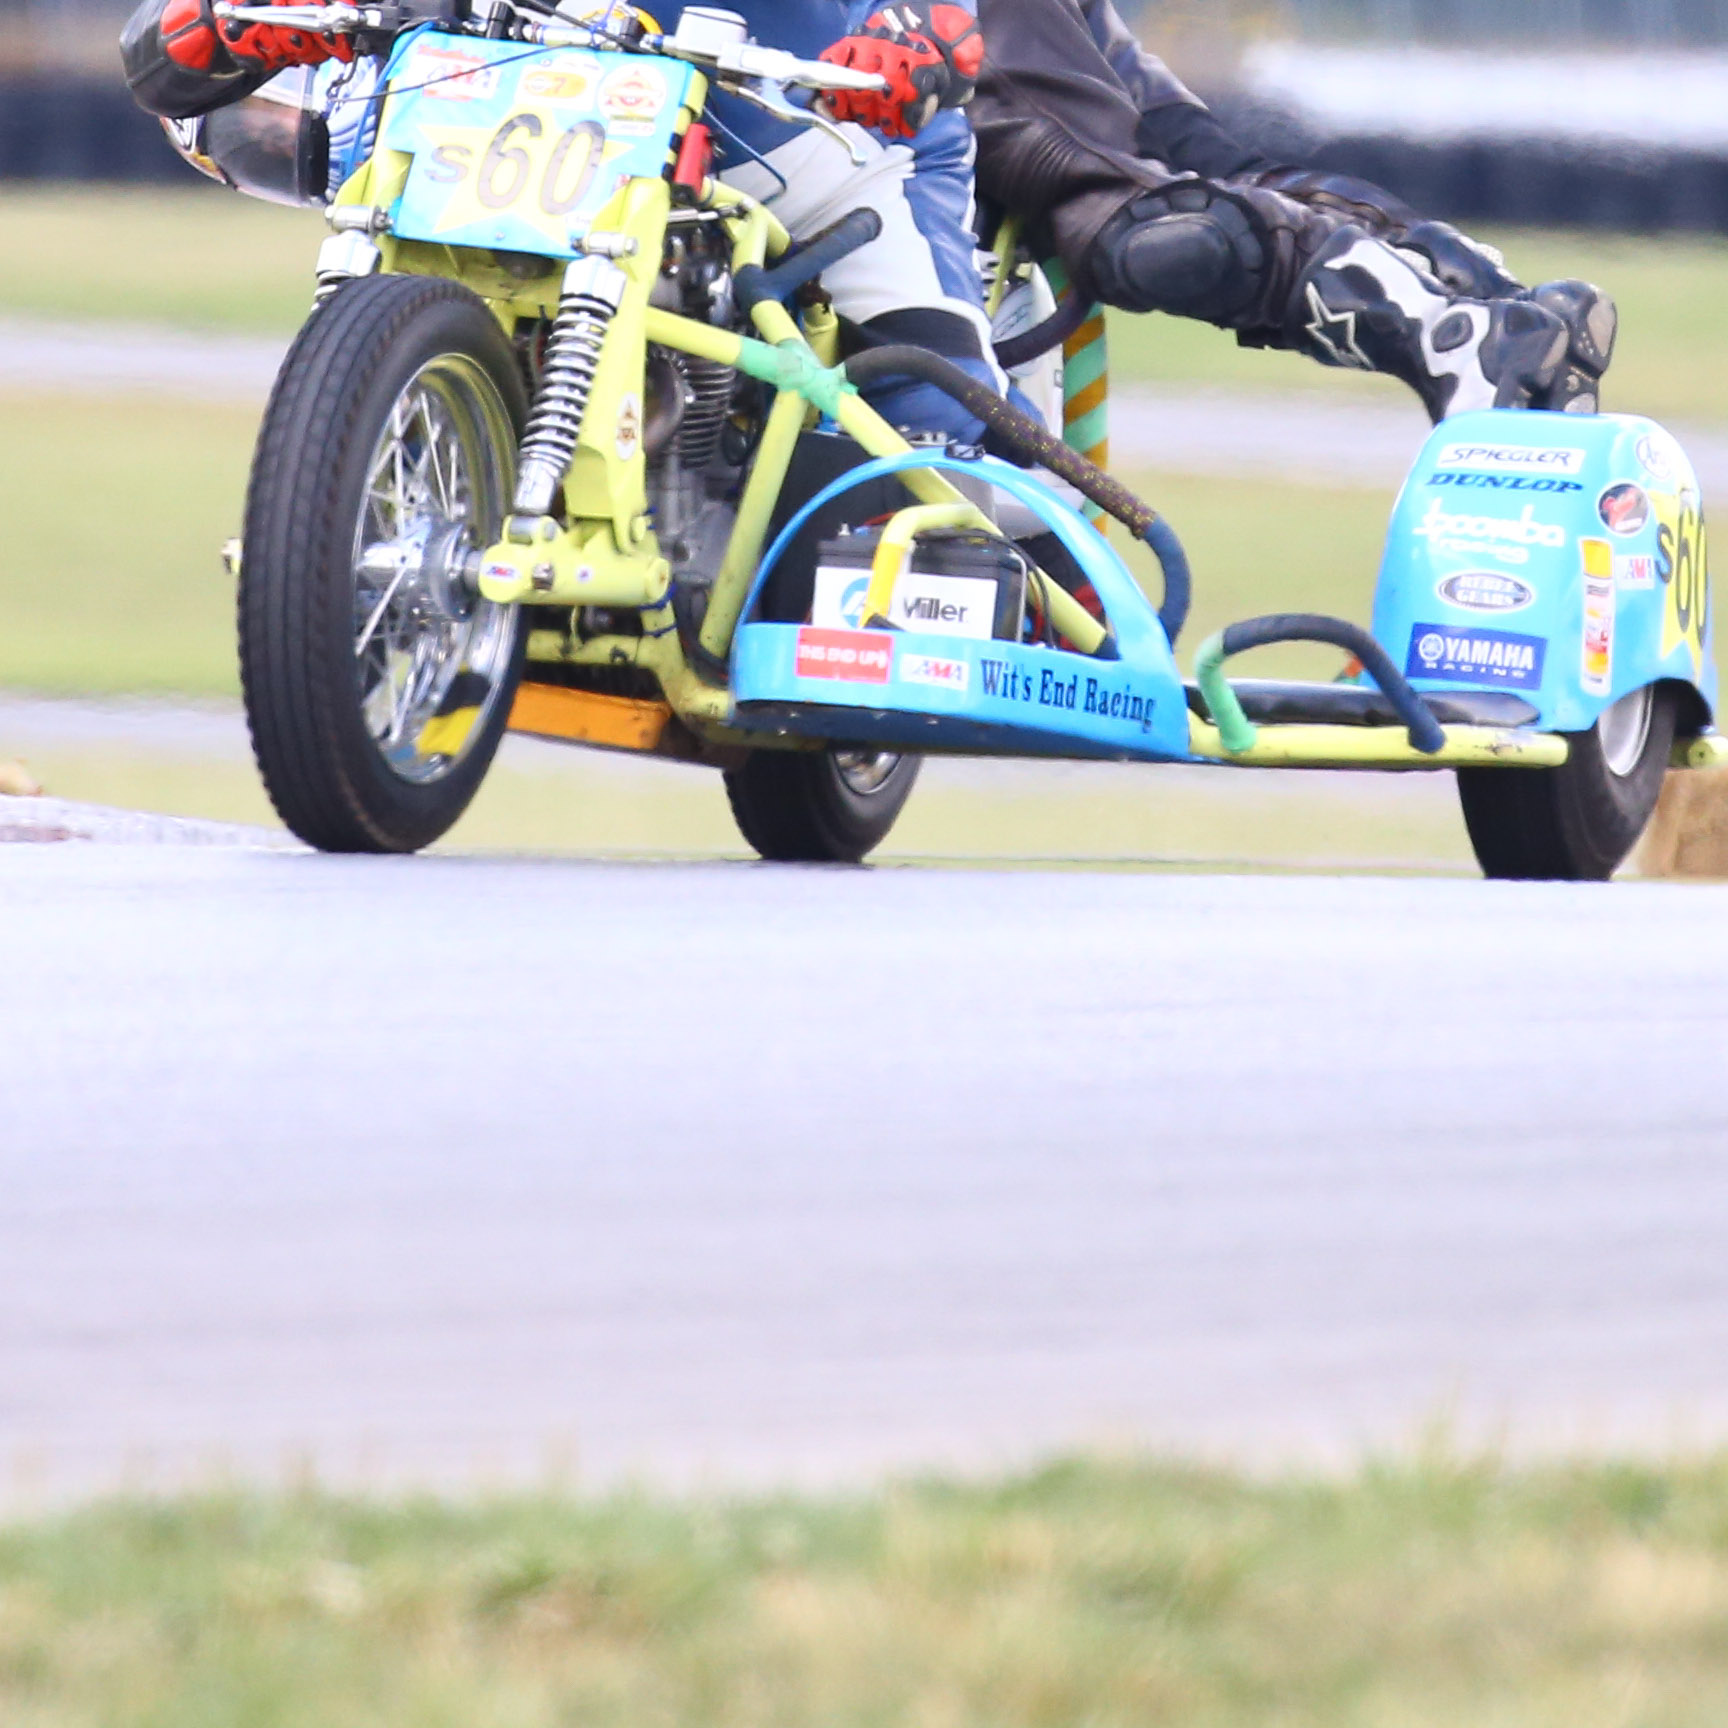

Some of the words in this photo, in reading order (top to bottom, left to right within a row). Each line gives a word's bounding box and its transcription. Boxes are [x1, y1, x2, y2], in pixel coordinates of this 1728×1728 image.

[1440, 448, 1571, 467] SPIEGLER
[1425, 473, 1584, 493] DUNLOP
[799, 643, 825, 660] THIS
[826, 647, 856, 663] END
[1445, 636, 1534, 670] YAMAHA
[912, 659, 963, 682] AMA
[1424, 662, 1525, 679] RACING
[981, 659, 1032, 702] Wit's
[1039, 668, 1078, 710] End
[1084, 677, 1156, 734] Racing
